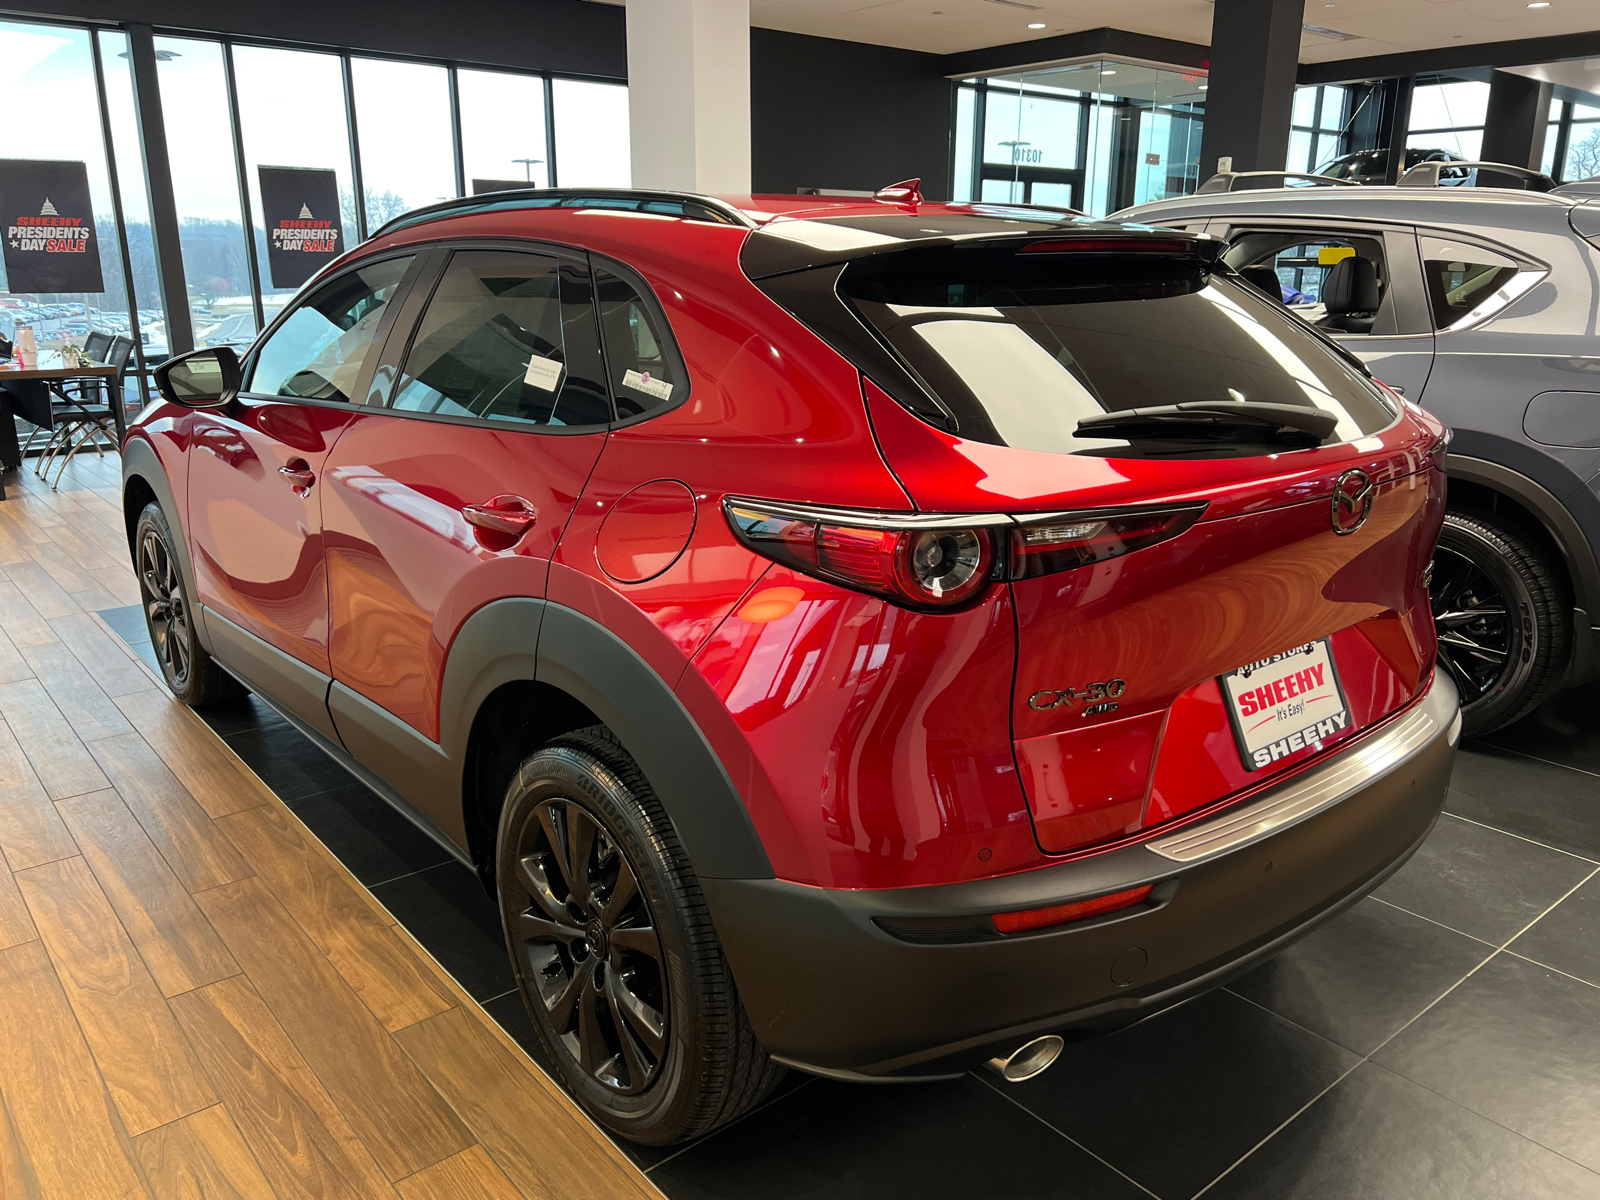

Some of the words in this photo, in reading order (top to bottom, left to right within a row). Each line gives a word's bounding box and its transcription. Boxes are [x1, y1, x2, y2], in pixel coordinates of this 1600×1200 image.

[16, 216, 83, 227] SHEEHY
[280, 220, 333, 229] SHEEHY
[8, 226, 90, 240] PRESIDENTS
[272, 228, 338, 240] PRESIDENTS
[20, 238, 47, 251] DAY
[46, 238, 87, 253] SALE
[282, 239, 304, 251] DAY
[302, 239, 335, 252] SALE
[1027, 677, 1126, 712] CX-30
[1238, 663, 1325, 718] SHEEHY
[1276, 707, 1289, 722] It's
[1287, 698, 1306, 716] Easy!
[1252, 710, 1347, 768] SHEEHY
